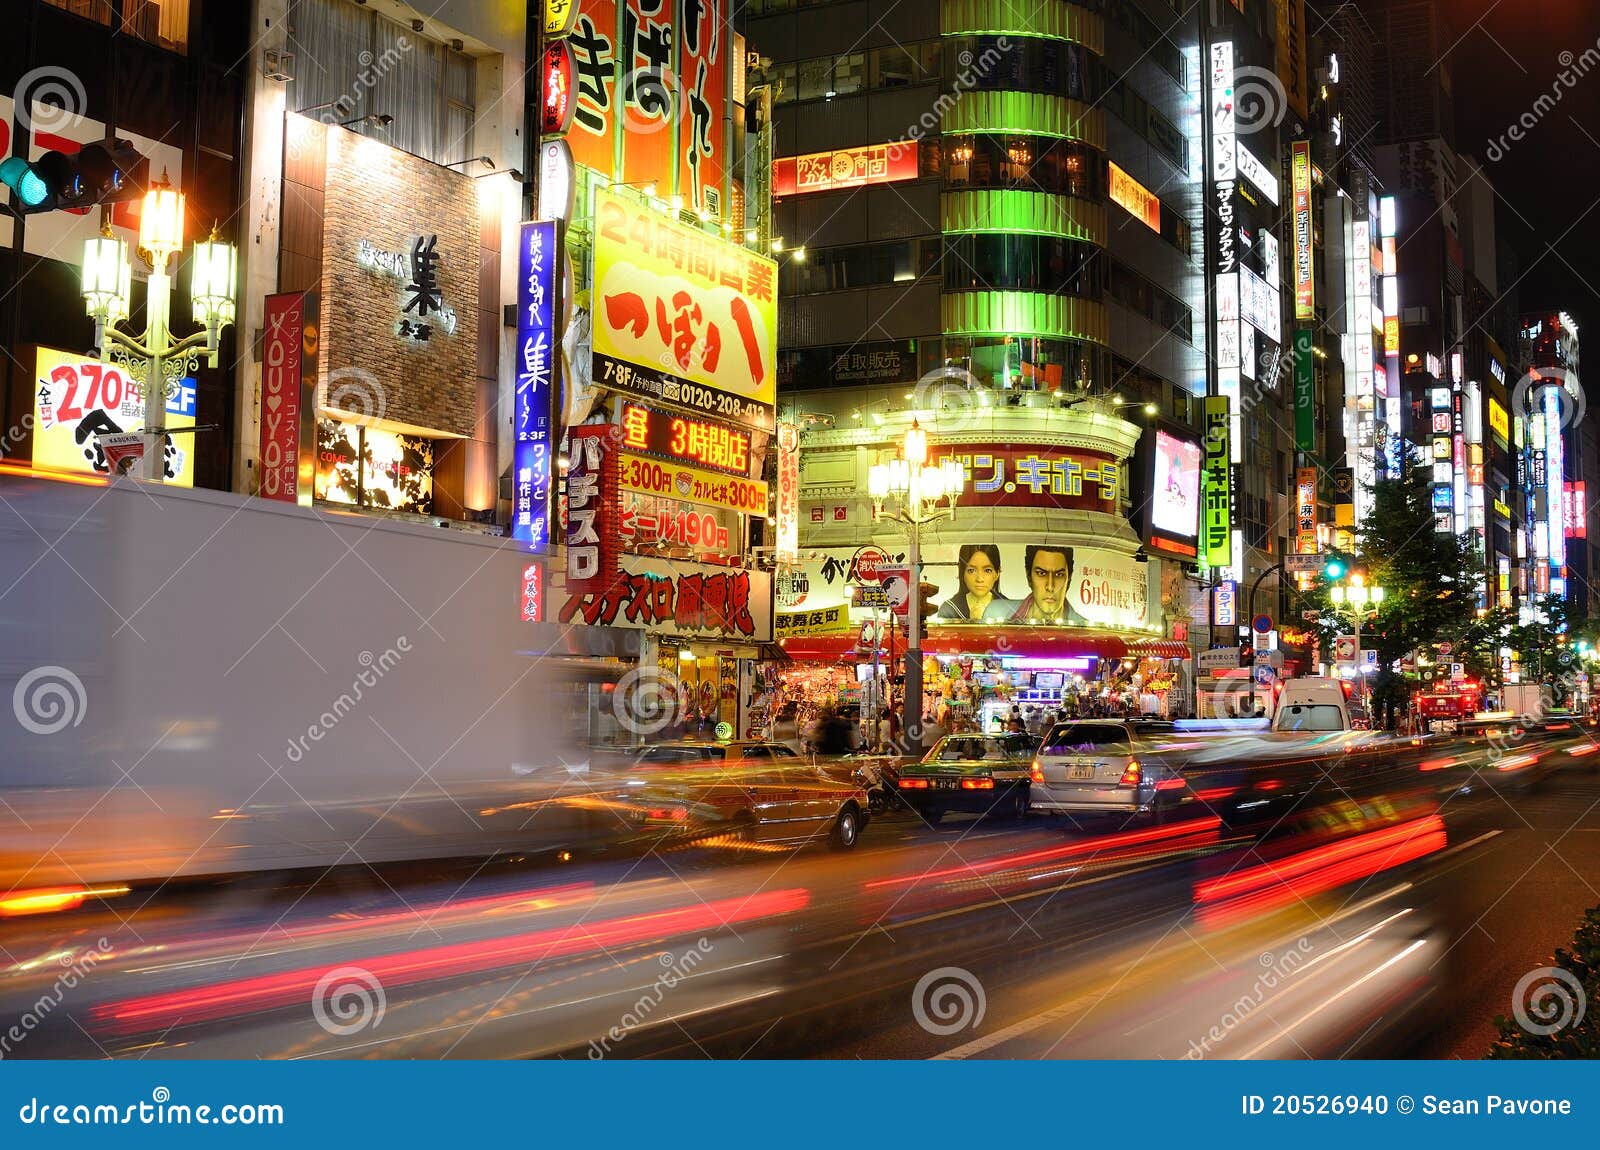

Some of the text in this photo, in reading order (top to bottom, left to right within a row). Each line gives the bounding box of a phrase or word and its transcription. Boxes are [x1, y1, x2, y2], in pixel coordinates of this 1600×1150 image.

[600, 200, 773, 304] 24時間営業
[604, 291, 764, 385] つぼ八
[836, 351, 900, 371] 買取販売
[1298, 371, 1310, 408] レイク
[320, 451, 347, 464] COME
[623, 406, 748, 473] 昼 3時開店
[533, 444, 545, 500] ワインと
[1208, 413, 1227, 549] ドン・キホーテ
[518, 467, 531, 525] 創作料理
[569, 436, 600, 580] パチスロ
[1299, 505, 1313, 531] 麻雀
[620, 503, 729, 549] ビール190円
[525, 582, 538, 622] 養老
[792, 580, 809, 593] END
[776, 608, 839, 629] 歌舞伎町
